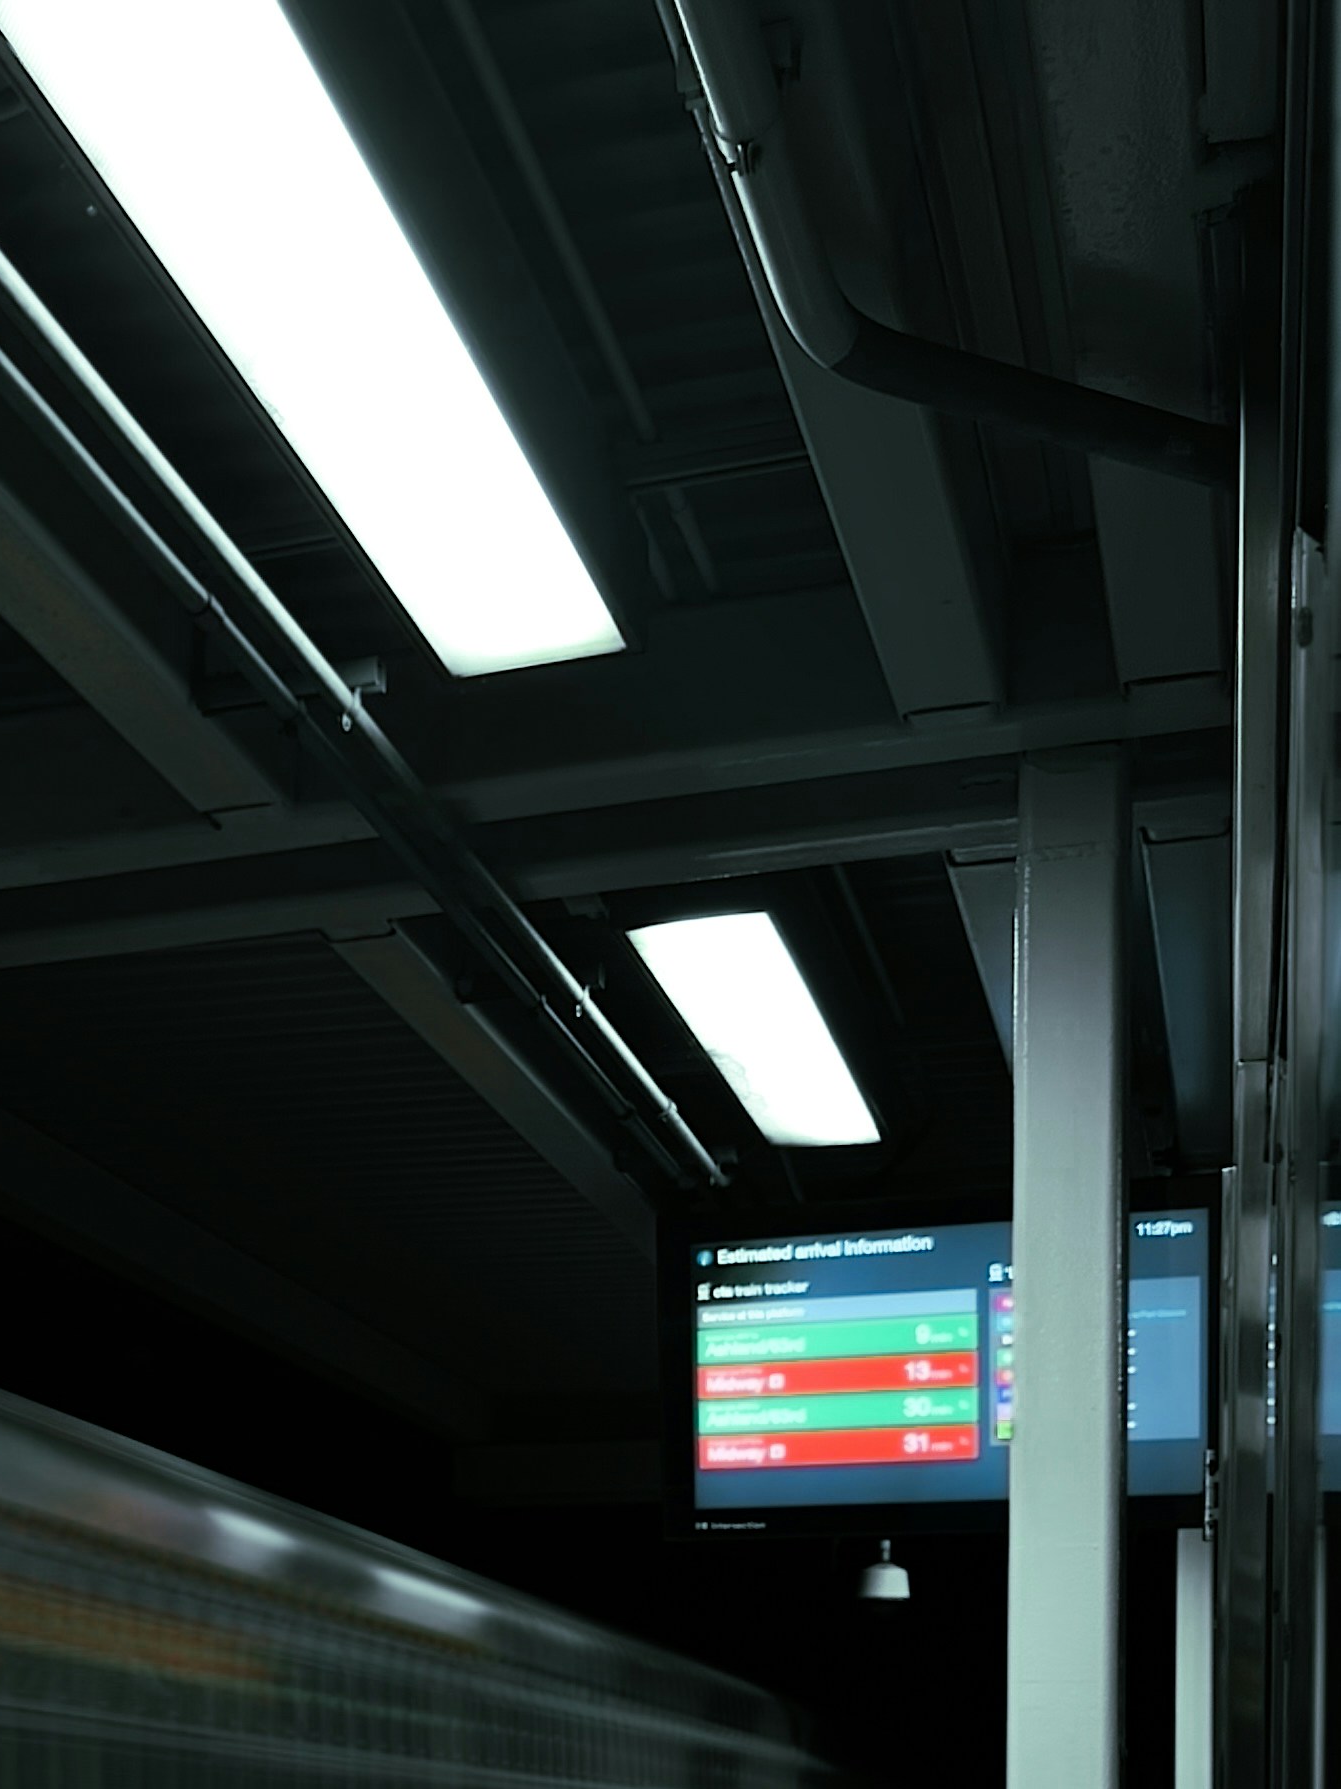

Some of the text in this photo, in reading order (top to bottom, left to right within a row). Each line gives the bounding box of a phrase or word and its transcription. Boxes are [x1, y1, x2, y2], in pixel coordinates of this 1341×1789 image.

[717, 1235, 934, 1265] Estimated arrival information
[713, 1285, 734, 1299] cta
[735, 1283, 763, 1297] train
[904, 1360, 930, 1381] 13
[902, 1396, 931, 1418] 30
[903, 1432, 929, 1454] 31
